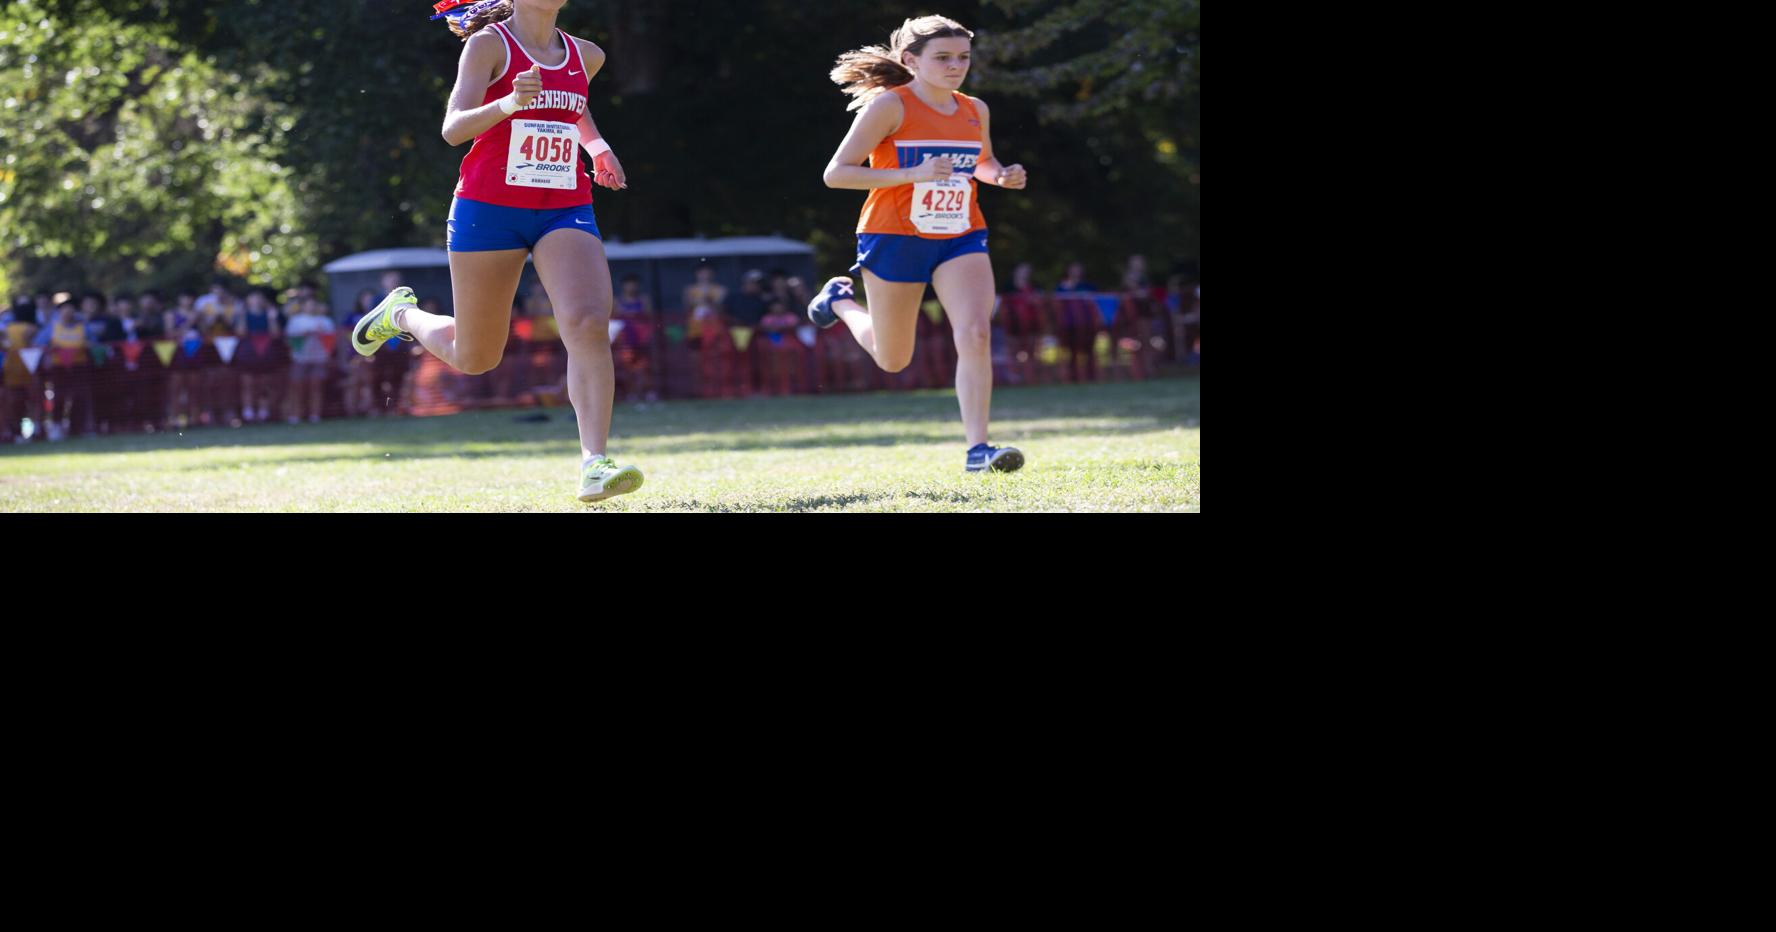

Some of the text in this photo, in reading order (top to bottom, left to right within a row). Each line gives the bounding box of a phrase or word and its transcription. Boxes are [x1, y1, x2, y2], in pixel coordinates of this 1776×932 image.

[521, 89, 587, 116] SENHOWE
[520, 135, 573, 163] 4058
[535, 163, 571, 172] BROOKS
[921, 189, 965, 211] 4229
